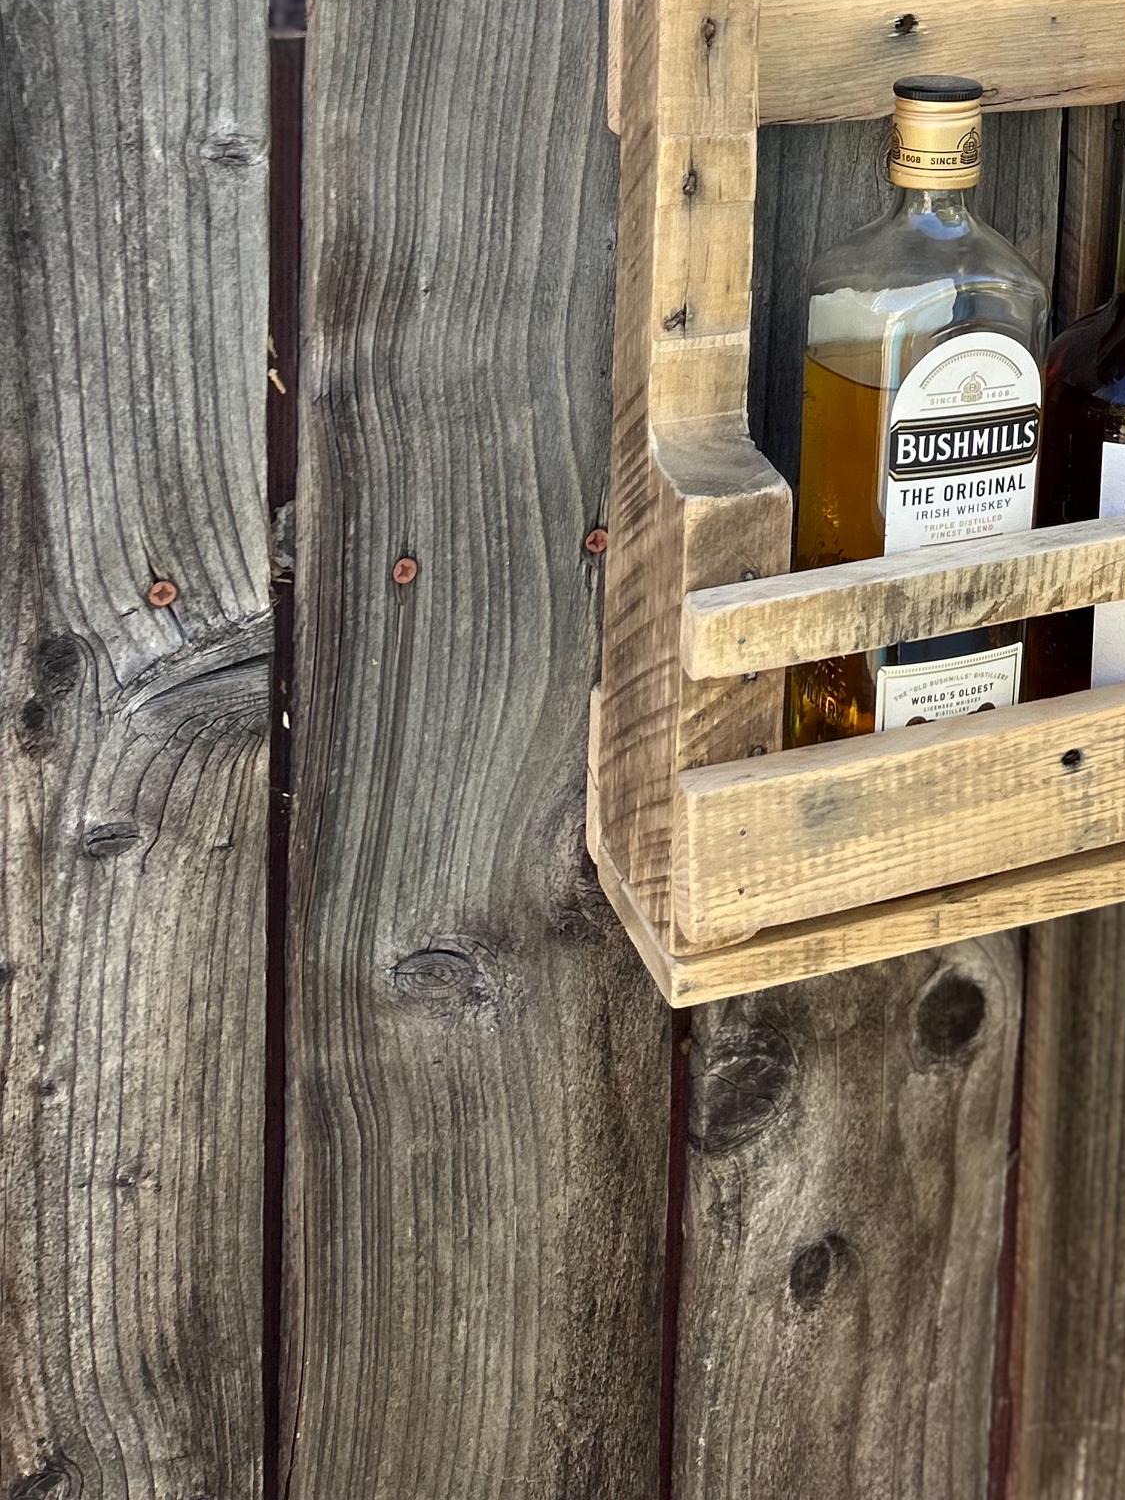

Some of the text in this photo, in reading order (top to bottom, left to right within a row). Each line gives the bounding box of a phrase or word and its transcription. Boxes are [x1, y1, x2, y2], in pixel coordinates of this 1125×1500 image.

[901, 153, 958, 165] 1608 SINCE
[930, 389, 1010, 406] SINCE 1608
[896, 420, 1037, 465] BUSHMILLS
[900, 473, 1026, 507] THE ORIGINAL
[916, 498, 1012, 521] IRISH WHISKEY
[924, 514, 1003, 532] TRIPLE DISTILLED
[931, 524, 994, 539] FINEST BLEND
[911, 682, 994, 706] WORLD'S OLDEST
